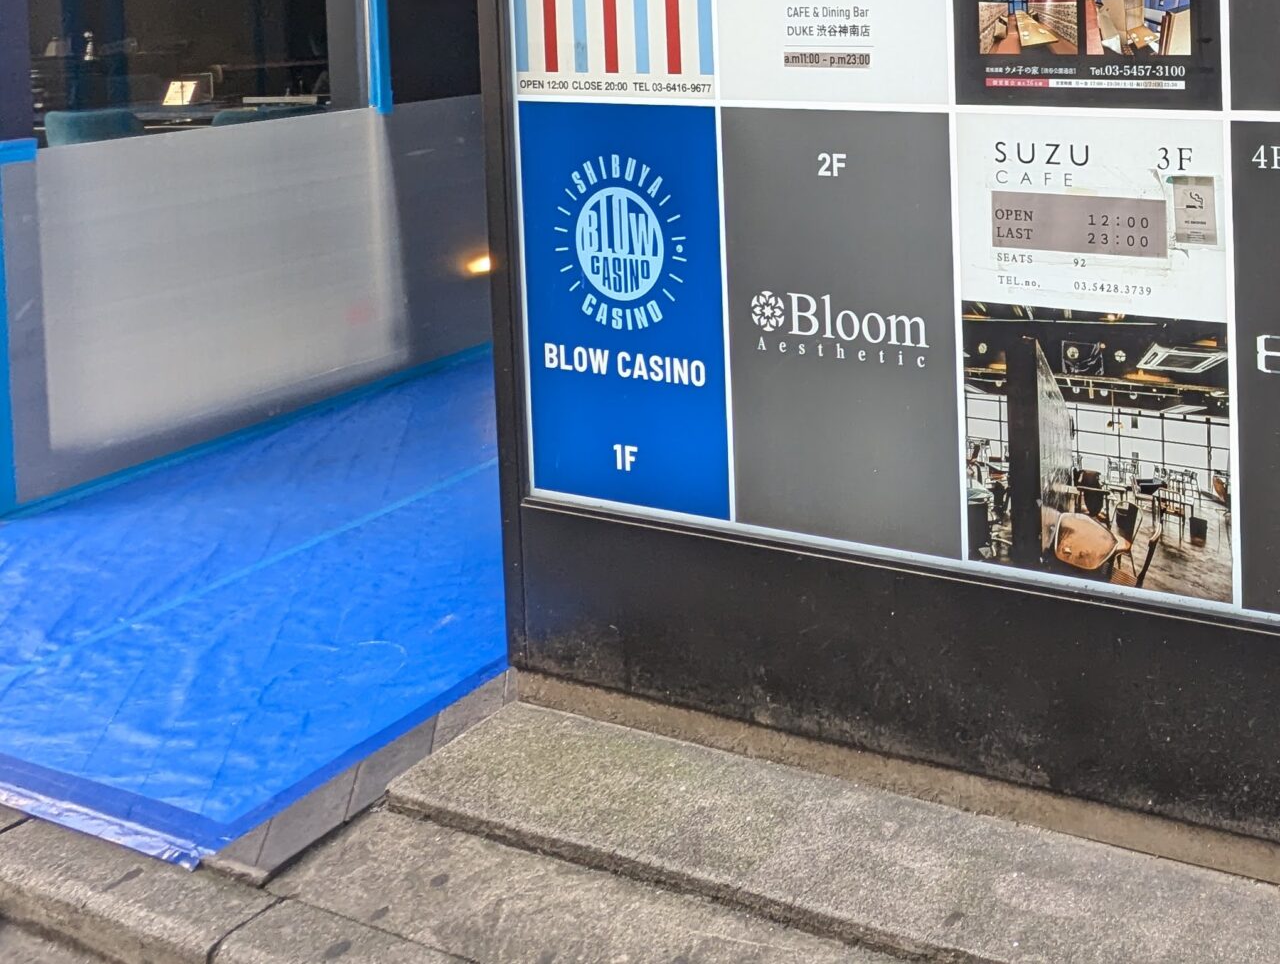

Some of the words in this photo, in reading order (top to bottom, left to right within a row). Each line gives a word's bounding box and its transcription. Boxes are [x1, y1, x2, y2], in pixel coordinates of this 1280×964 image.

[787, 6, 810, 17] CAFE
[813, 7, 819, 17] &
[822, 6, 850, 20] Dining
[853, 6, 869, 17] Bar
[787, 26, 814, 36] DUKE
[816, 24, 870, 37] 渋谷神南店
[519, 80, 544, 89] OPEN
[547, 80, 569, 90] 12:00
[572, 81, 602, 91] CLOSE
[605, 82, 628, 91] 20:00
[633, 82, 650, 92] TEL
[652, 83, 712, 93] 03-6416-9677
[817, 152, 846, 177] 2F
[994, 141, 1089, 166] SUZU
[1157, 147, 1193, 171] 3F
[571, 154, 663, 198] SHIBUYA
[995, 170, 1073, 187] CAFE
[582, 193, 658, 257] BLOW
[994, 209, 1034, 222] OPEN
[1087, 214, 1149, 229] 12:00
[996, 227, 1034, 240] LAST
[1087, 233, 1149, 248] 23:00
[997, 252, 1033, 264] SEATS
[1073, 257, 1087, 268] 92
[591, 255, 650, 293] CASINO
[997, 275, 1041, 288] TEL.no.
[1073, 281, 1152, 296] 03.5428.3739
[581, 293, 663, 331] CASINO
[787, 292, 930, 348] Bloom
[544, 342, 609, 378] BLOW
[617, 351, 706, 387] CASINO
[757, 336, 927, 368] Aesthetic
[613, 443, 638, 472] 1F
